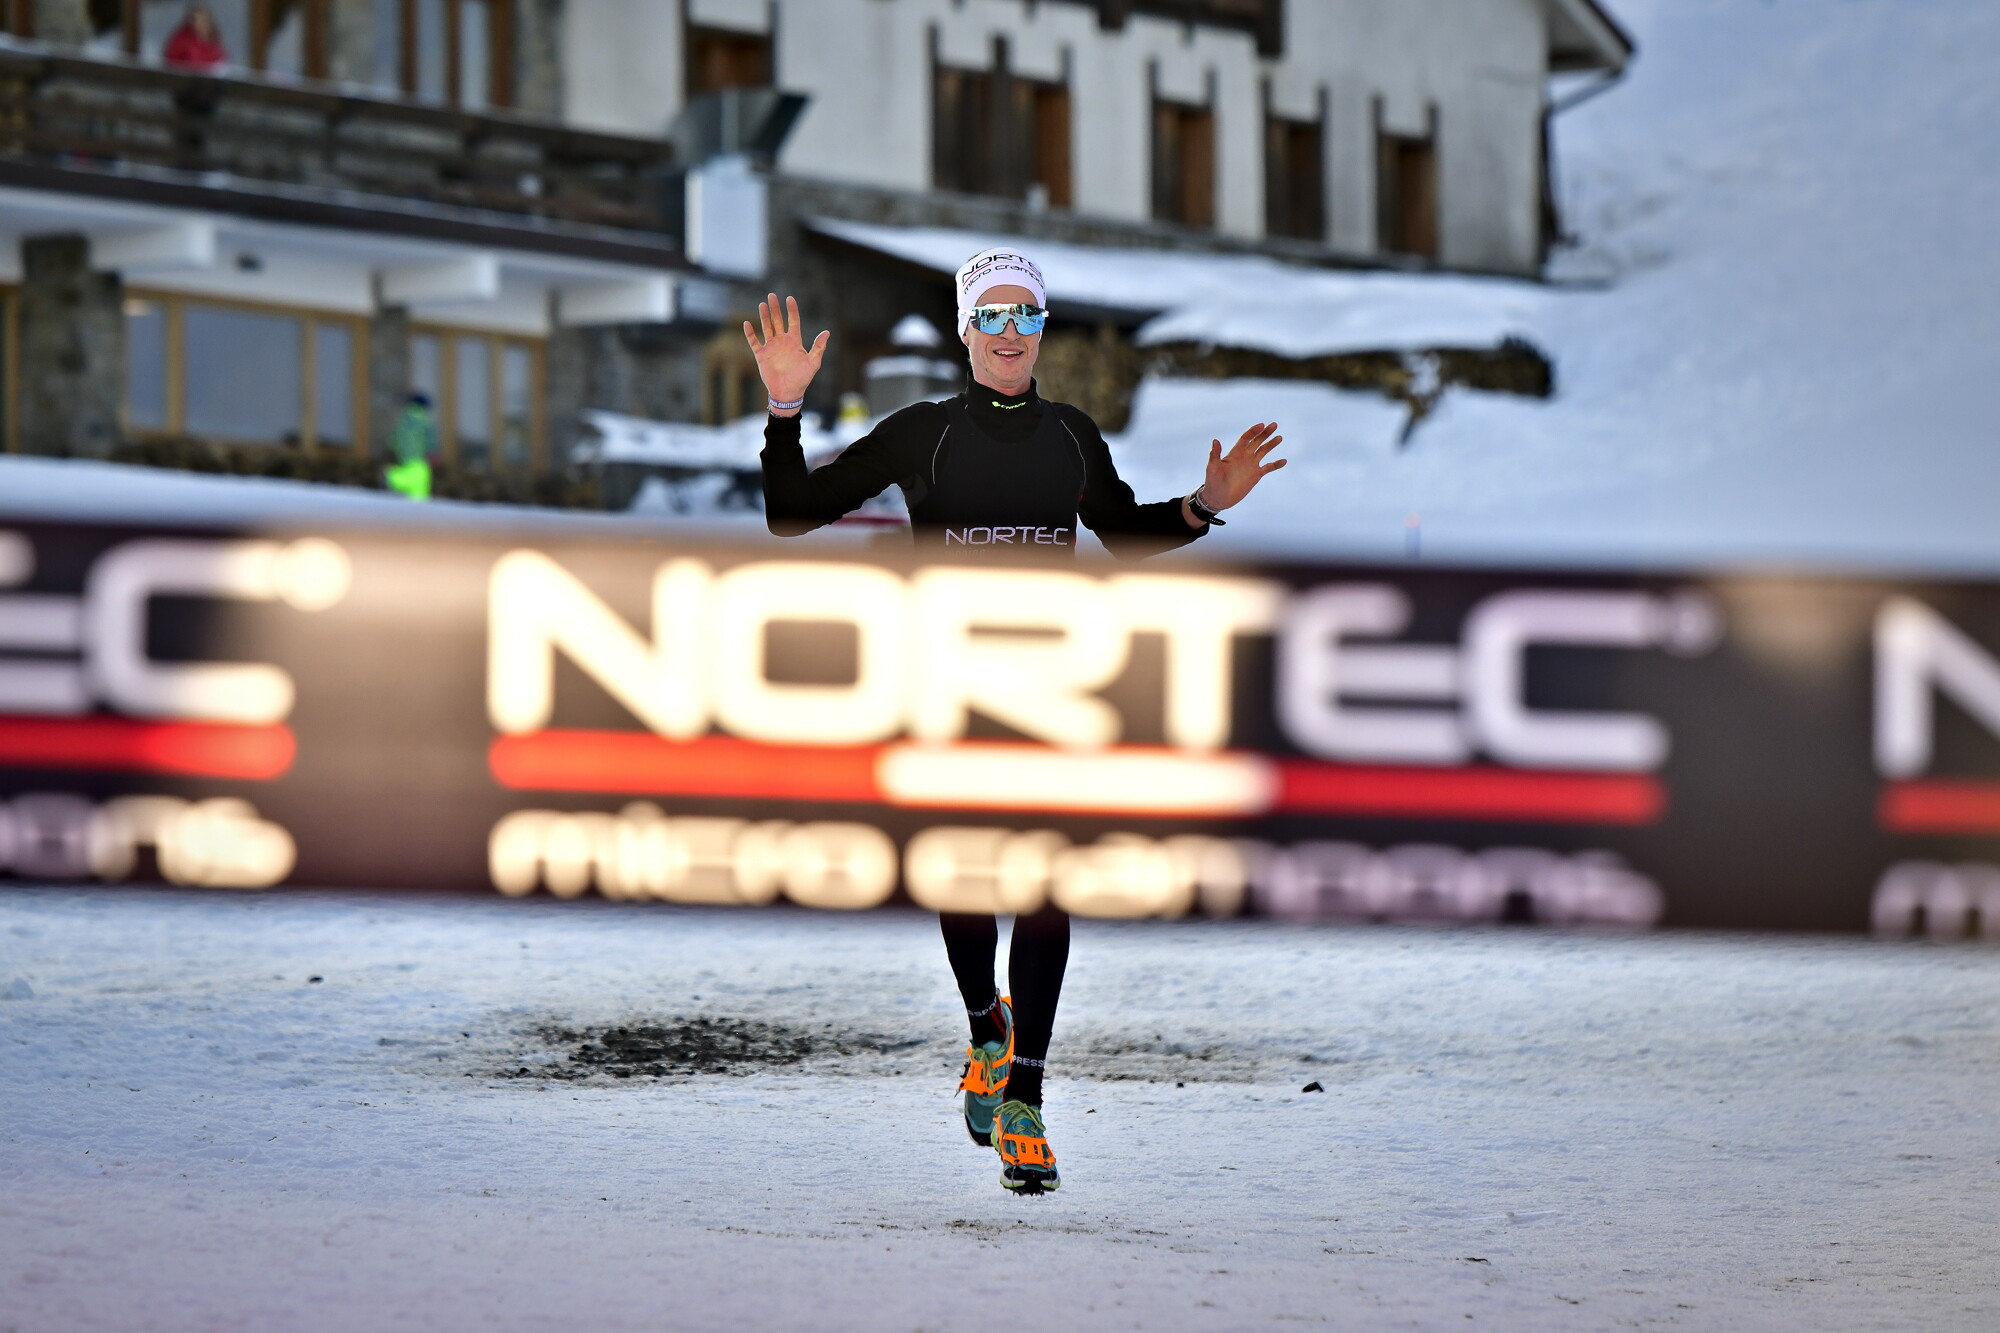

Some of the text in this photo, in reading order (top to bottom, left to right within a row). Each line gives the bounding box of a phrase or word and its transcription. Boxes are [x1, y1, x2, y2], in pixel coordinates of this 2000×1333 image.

[964, 267, 992, 295] micro
[945, 526, 1069, 546] NORTEC
[486, 548, 1670, 774] NORTEC
